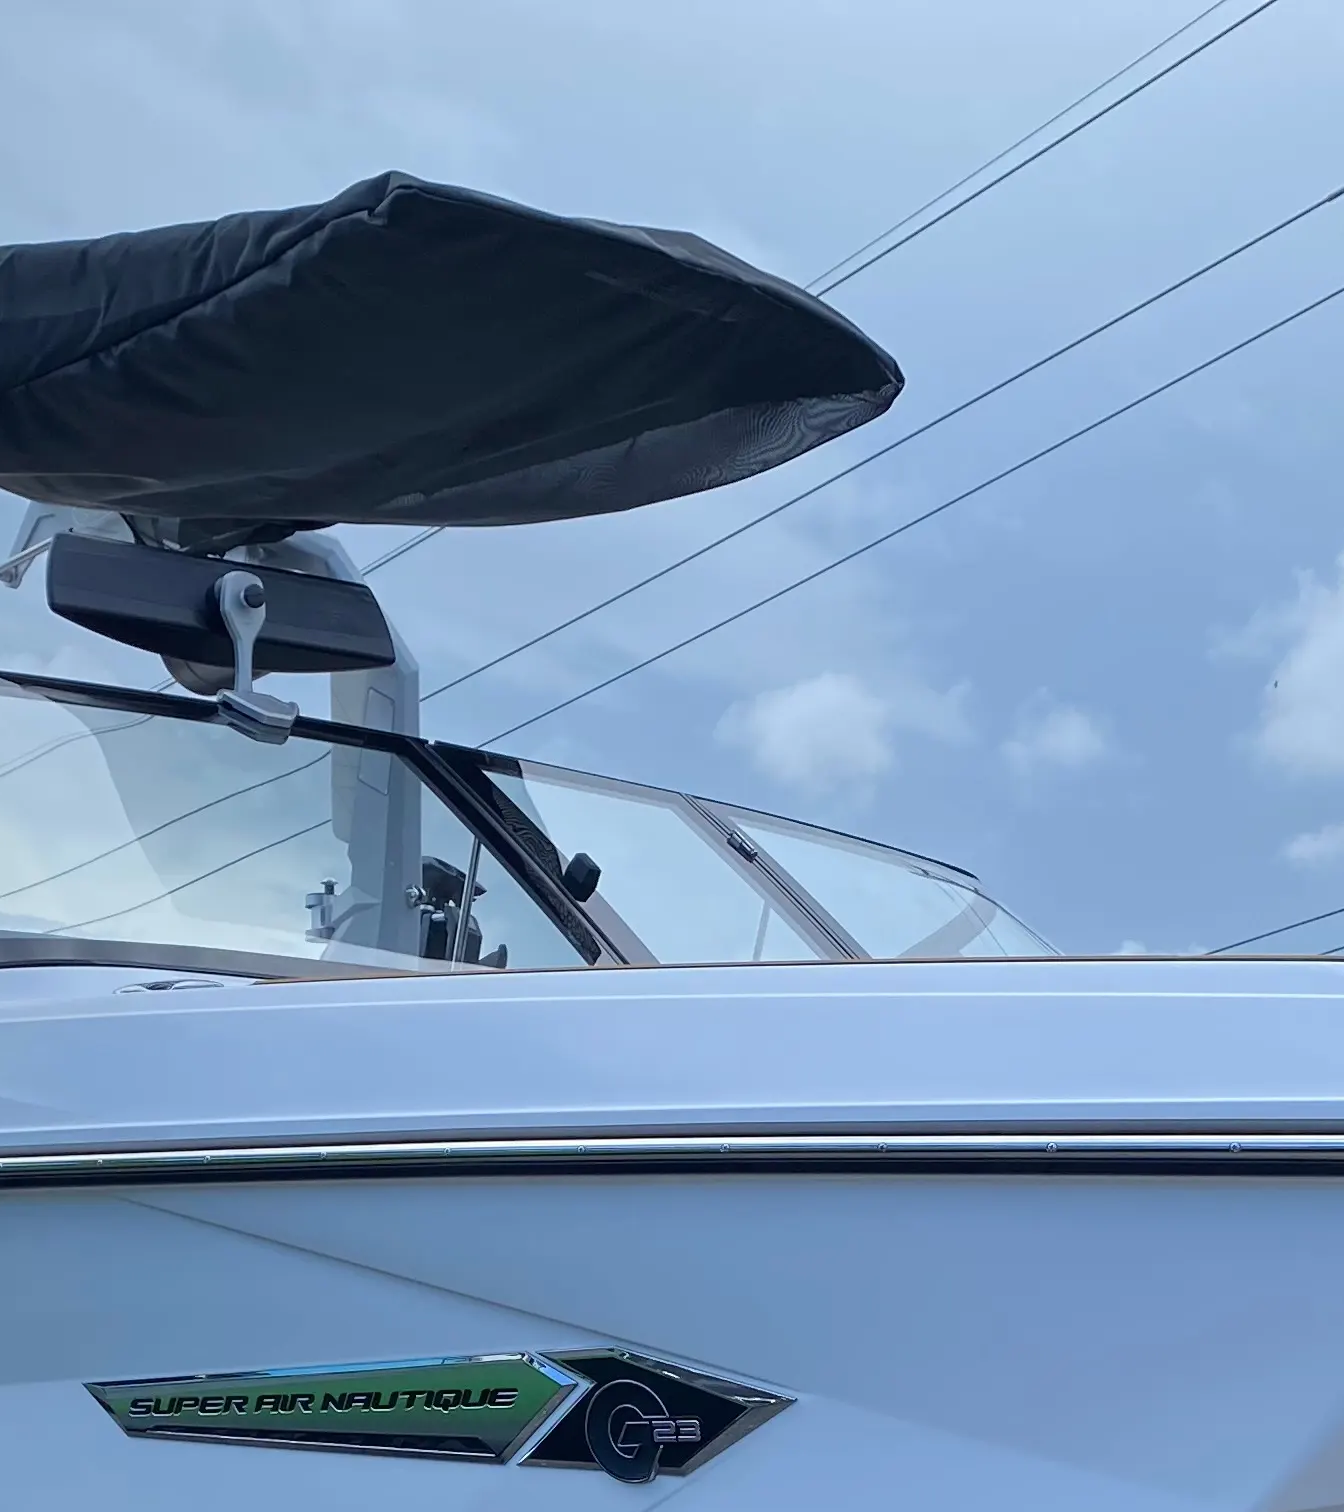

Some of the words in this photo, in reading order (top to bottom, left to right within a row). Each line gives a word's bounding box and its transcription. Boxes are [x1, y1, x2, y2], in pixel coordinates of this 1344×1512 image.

[128, 1395, 249, 1418] SUPER
[253, 1393, 316, 1415] AIR
[319, 1387, 519, 1414] NAUTIQUE
